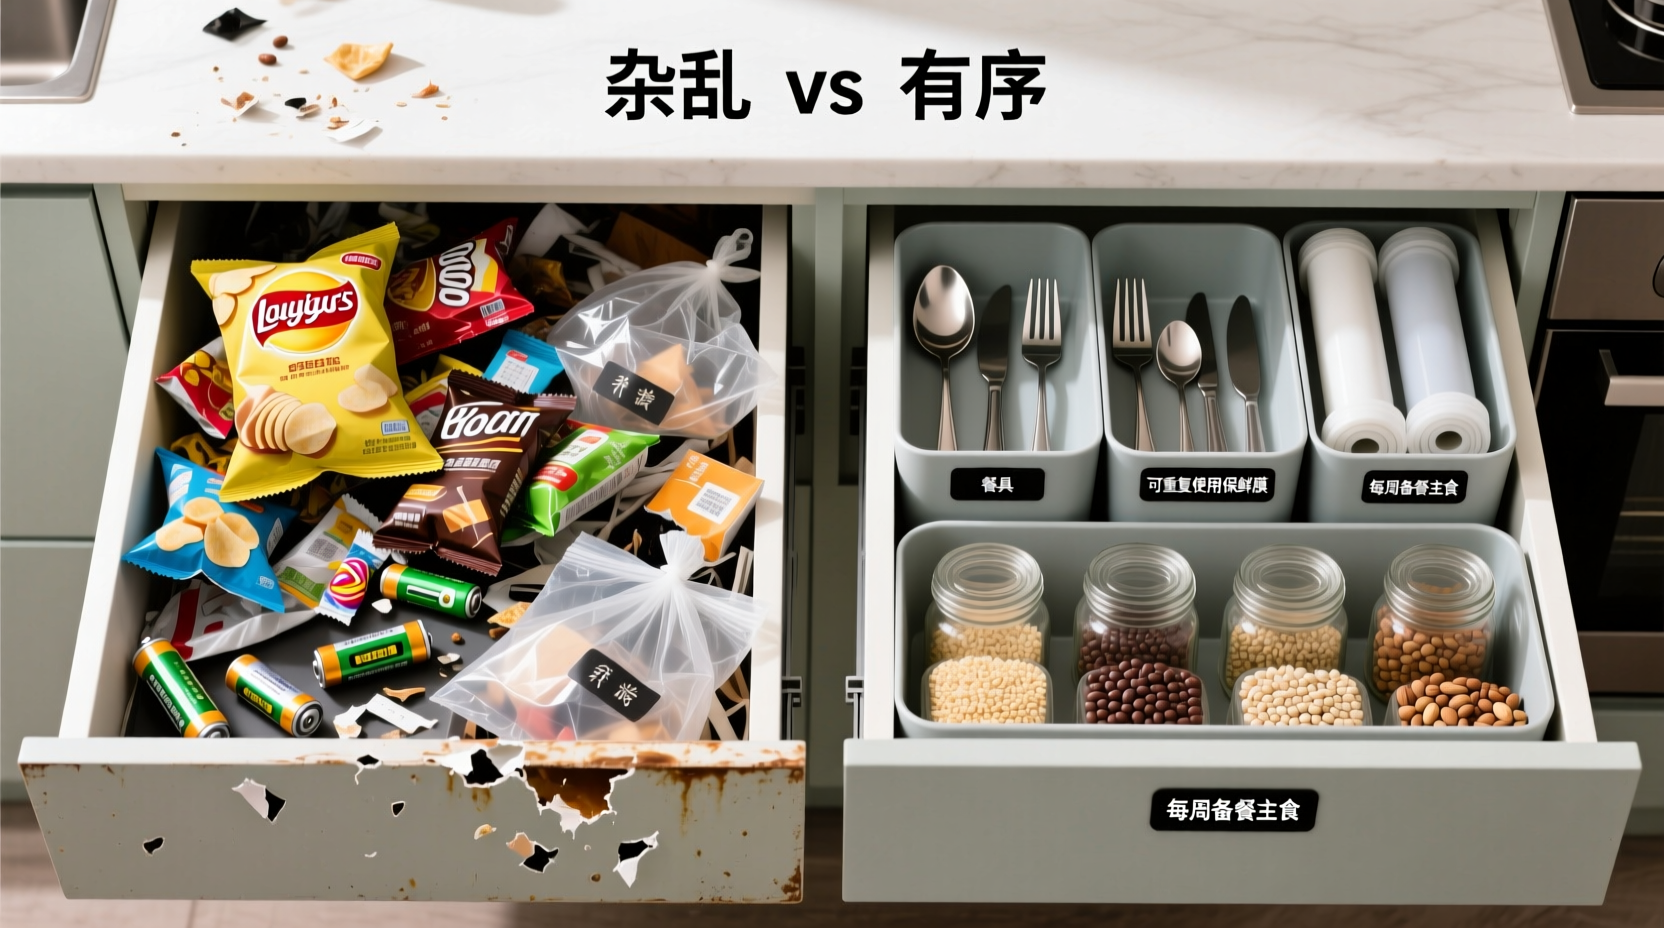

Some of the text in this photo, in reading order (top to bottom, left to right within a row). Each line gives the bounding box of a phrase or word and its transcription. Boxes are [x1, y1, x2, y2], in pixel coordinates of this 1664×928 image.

[981, 476, 1014, 493] 餐具
[1166, 798, 1300, 821] 每周备餐主食
